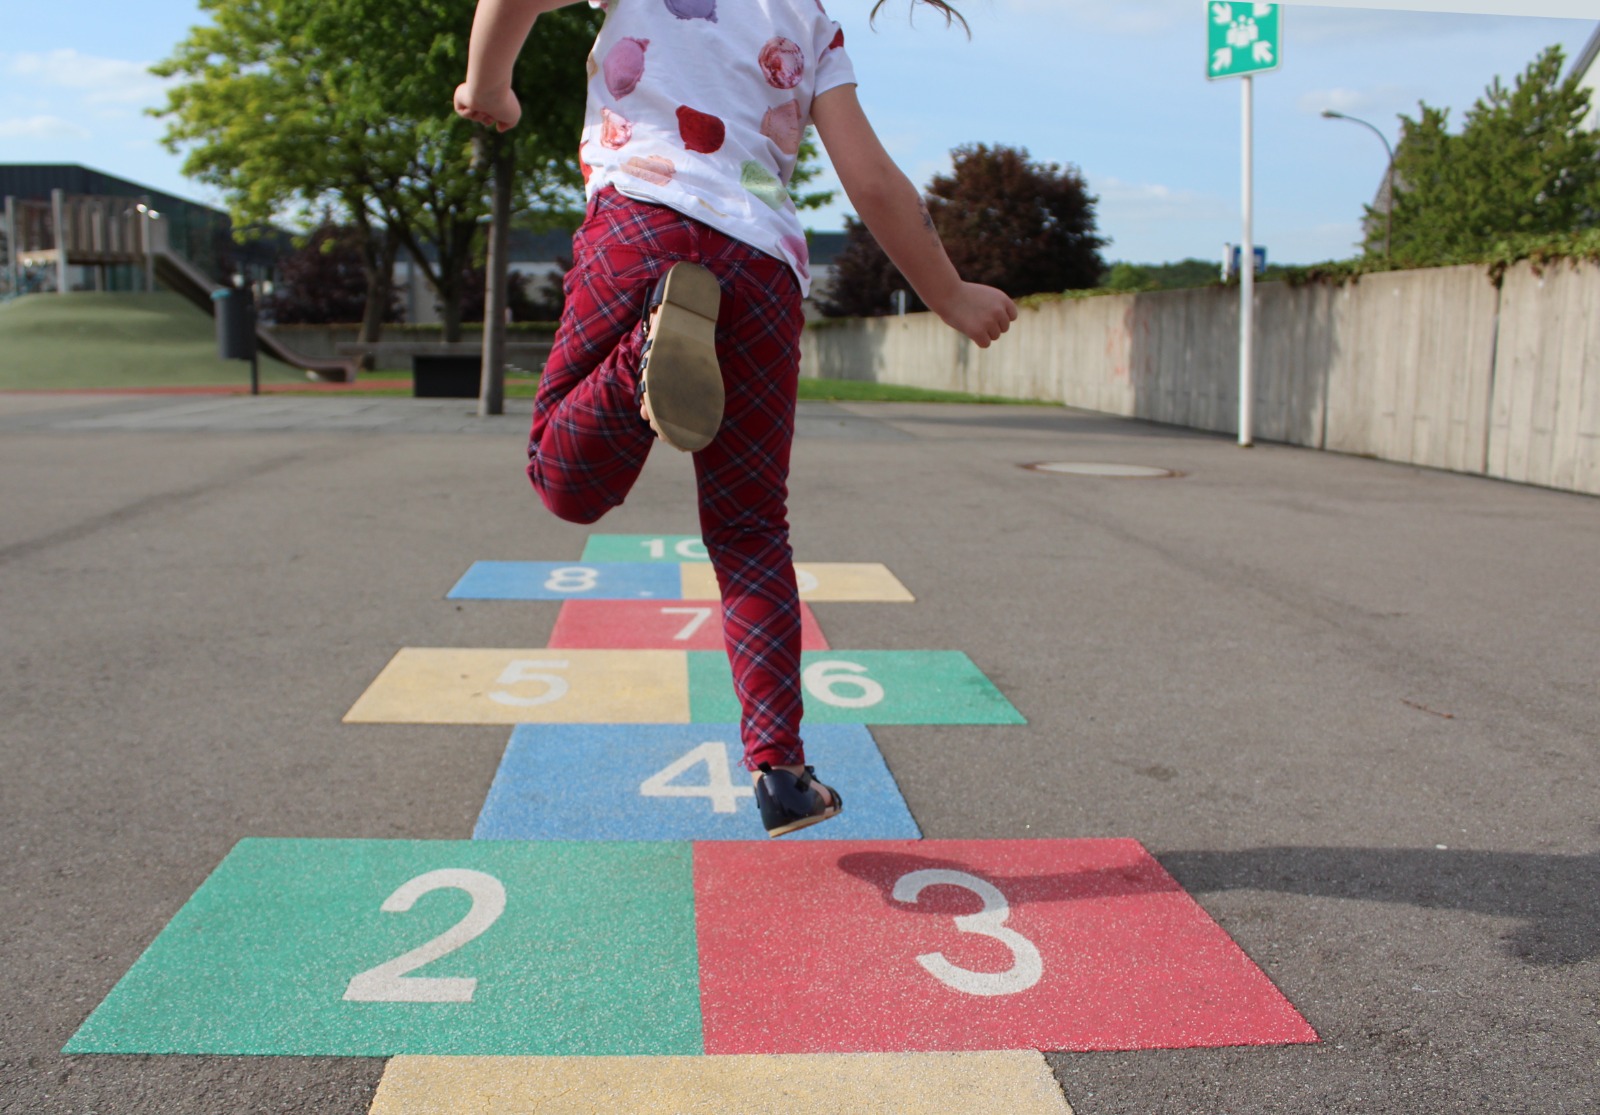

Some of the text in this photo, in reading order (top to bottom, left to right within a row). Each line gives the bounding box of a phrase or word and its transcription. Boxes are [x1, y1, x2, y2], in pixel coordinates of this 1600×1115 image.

[544, 566, 599, 592] 8
[661, 607, 711, 640] 7
[488, 660, 569, 706] 5
[803, 660, 885, 708] 6
[639, 742, 756, 814] 4
[342, 868, 508, 1003] 2
[892, 868, 1044, 997] 3
